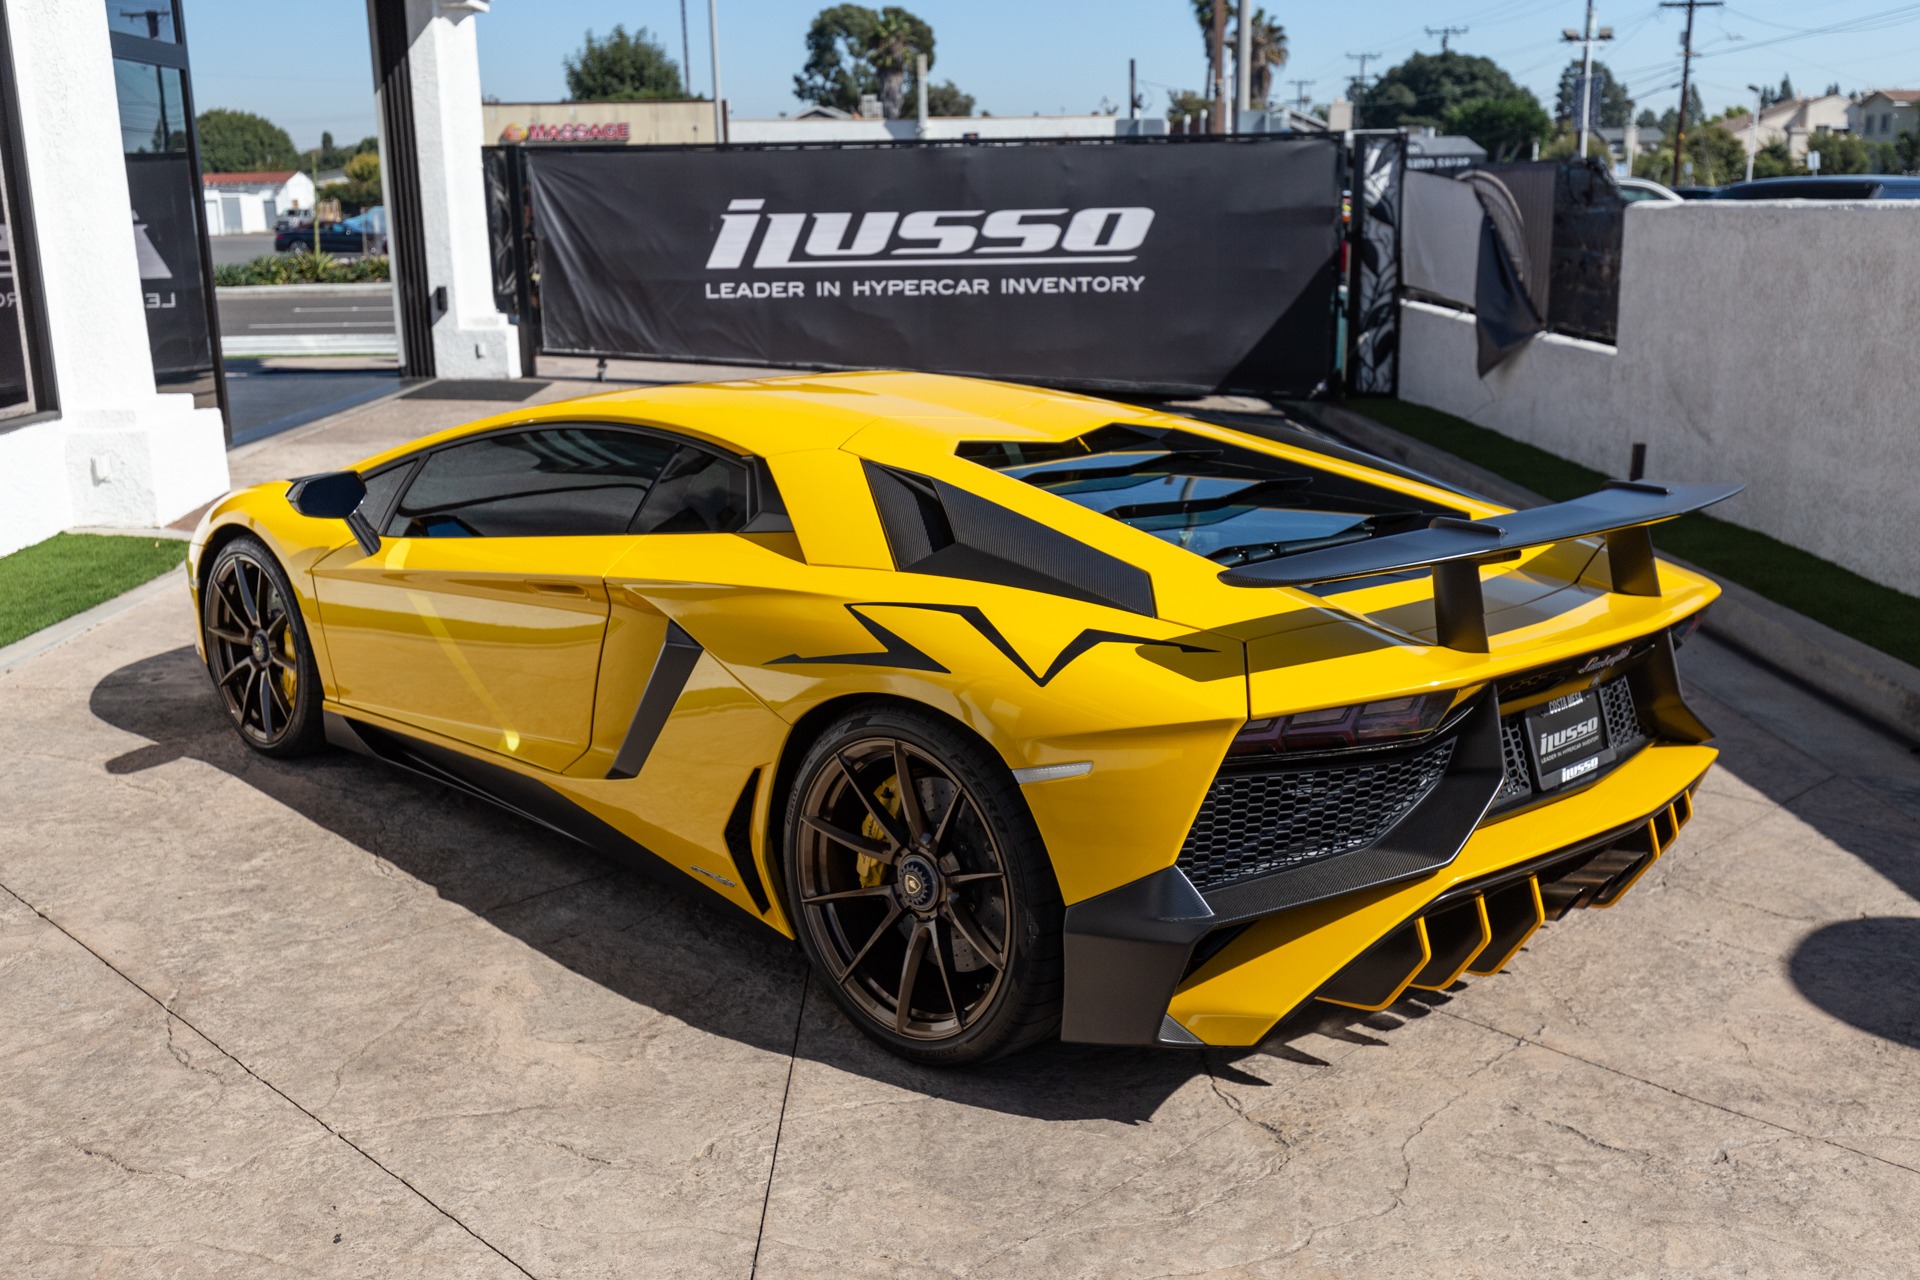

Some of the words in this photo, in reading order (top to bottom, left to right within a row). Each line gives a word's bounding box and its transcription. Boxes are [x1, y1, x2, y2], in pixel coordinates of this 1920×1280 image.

[529, 123, 630, 140] MASSAGE
[705, 281, 805, 299] LEADER
[816, 280, 841, 298] IN
[852, 278, 990, 297] HYPERCAR
[1001, 275, 1145, 295] INVENTORY
[1548, 697, 1568, 715] COSTA
[1567, 691, 1584, 708] MESA
[1540, 752, 1557, 764] LEADER
[1562, 742, 1582, 755] HYPERCAR
[1581, 735, 1600, 748] INVENTORY
